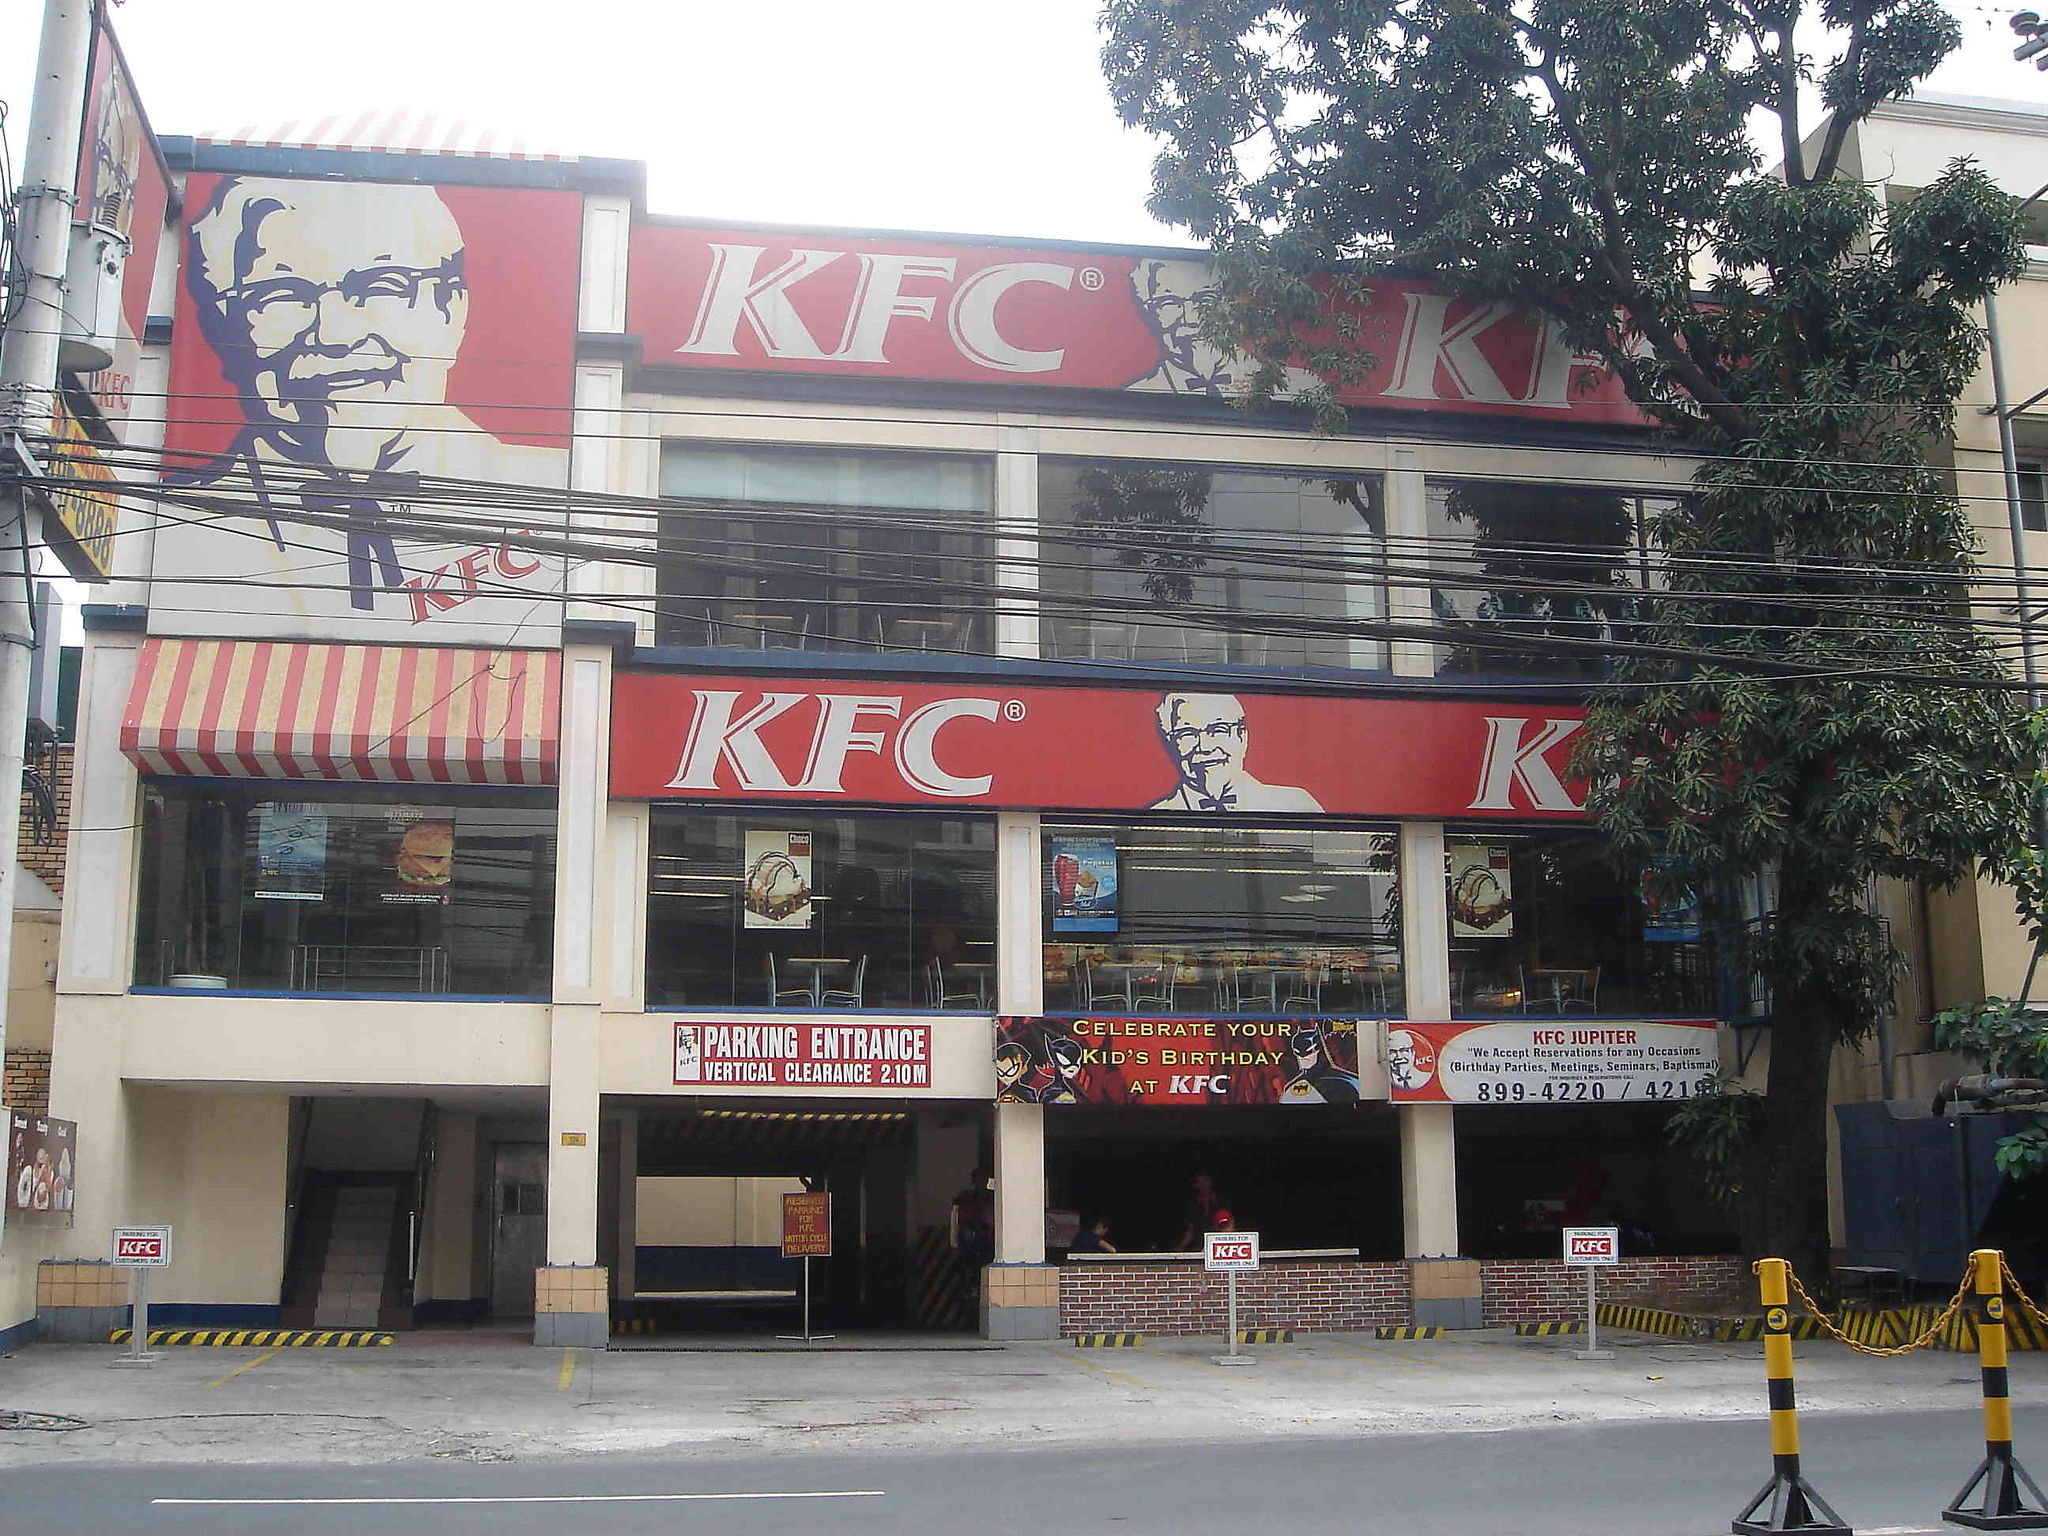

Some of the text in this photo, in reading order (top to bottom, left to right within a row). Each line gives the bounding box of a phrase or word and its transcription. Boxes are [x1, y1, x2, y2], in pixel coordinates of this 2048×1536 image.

[674, 243, 1075, 373] KFC
[98, 371, 132, 410] KFC
[404, 530, 541, 625] KFC
[664, 690, 1001, 797] KFC
[1073, 1020, 1292, 1037] CELEBRATE YOUR
[704, 1026, 927, 1061] PARKING ENTRANCE
[1533, 1030, 1637, 1045] KFC JUPITER
[1083, 1049, 1285, 1065] KID'S BIRTHDAY
[1493, 1047, 1530, 1060] Accept
[1534, 1047, 1603, 1058] Reservations
[1607, 1047, 1618, 1057] for
[1626, 1049, 1644, 1058] any
[1648, 1046, 1701, 1056] Occasions
[679, 1057, 698, 1067] KFC
[1415, 1056, 1433, 1066] KFC
[1450, 1059, 1719, 1074] (Birthday Parties, Meetings, Seminars, Baptismal)
[704, 1061, 777, 1082] VERTICAL
[785, 1063, 872, 1084] CLEARANCE
[1130, 1075, 1230, 1095] AT KFC
[1478, 1082, 1605, 1101] 899-4220
[799, 1215, 814, 1223] FOR
[799, 1224, 815, 1233] KFC
[121, 1241, 160, 1254] KFC
[1214, 1244, 1251, 1258] KFC
[1573, 1240, 1610, 1253] KFC
